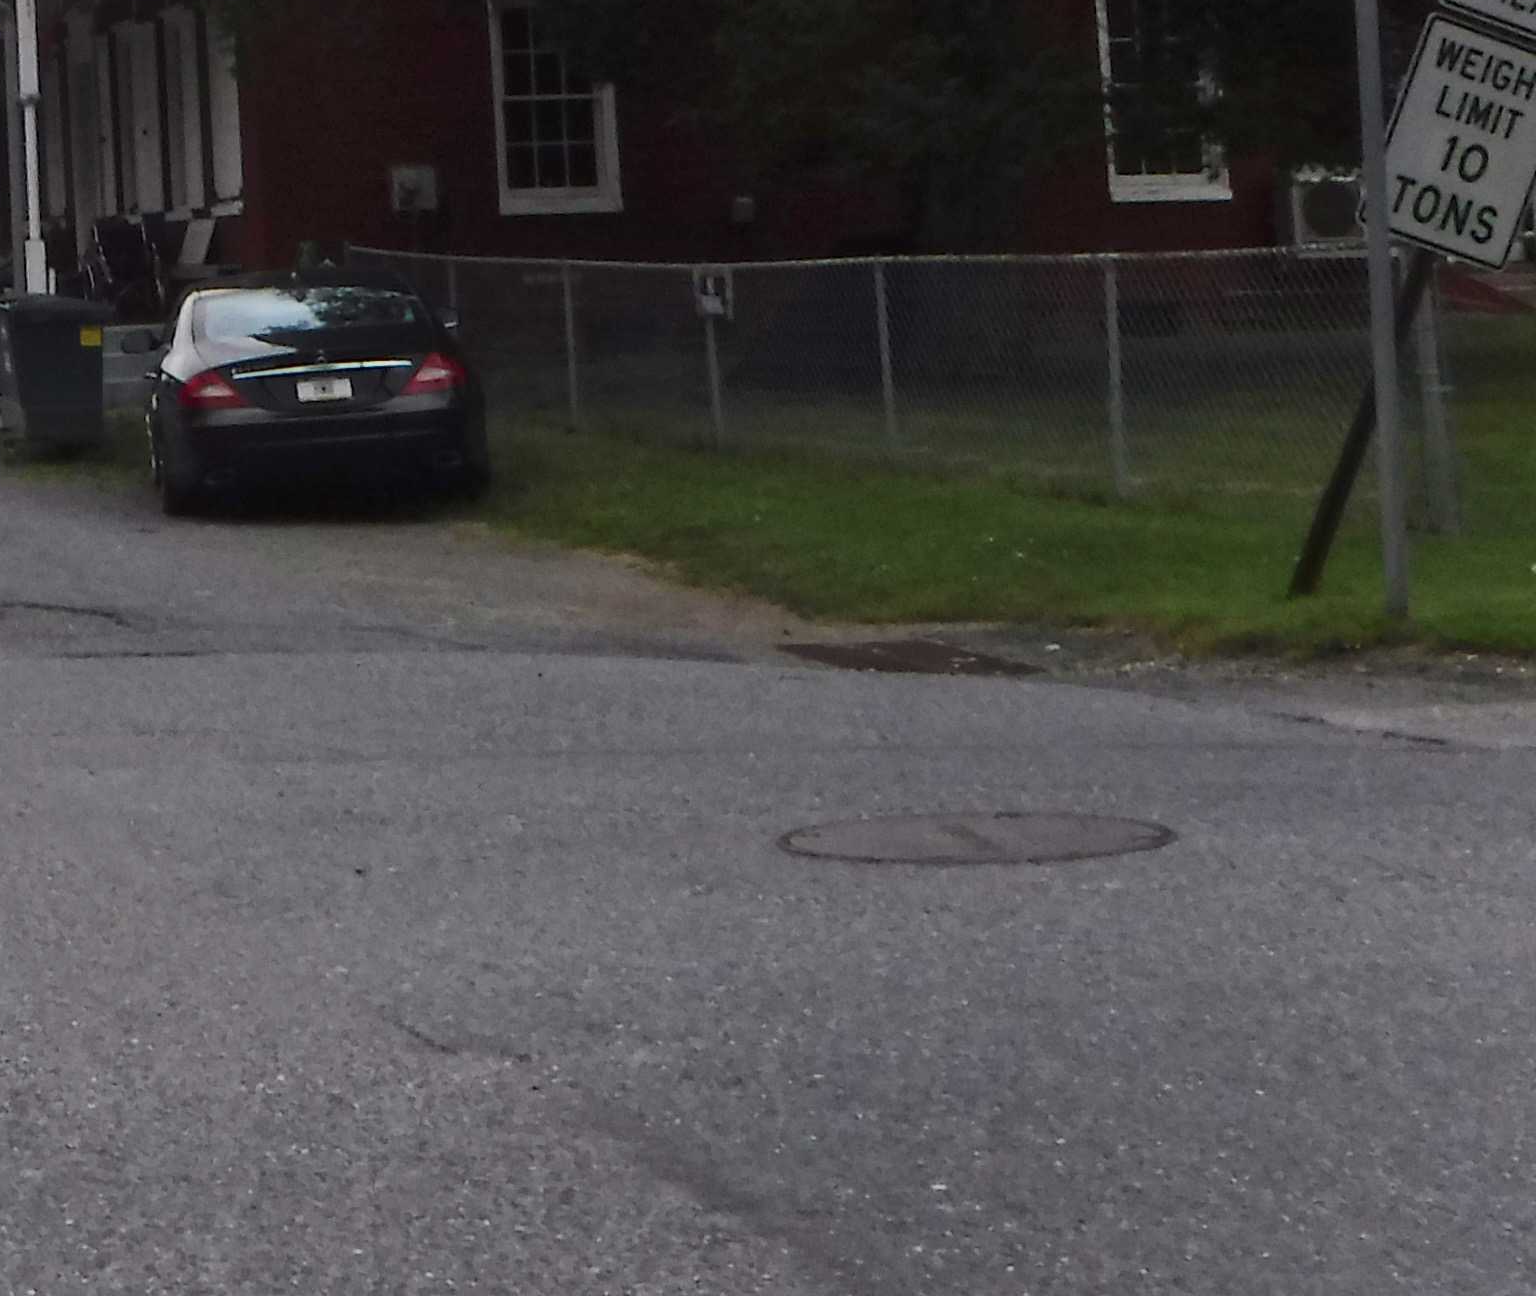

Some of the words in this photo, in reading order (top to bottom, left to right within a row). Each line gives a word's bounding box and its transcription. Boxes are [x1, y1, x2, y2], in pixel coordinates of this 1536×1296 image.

[1435, 84, 1525, 140] LIMIT
[1440, 135, 1489, 184] 10
[1392, 174, 1499, 244] TONS
